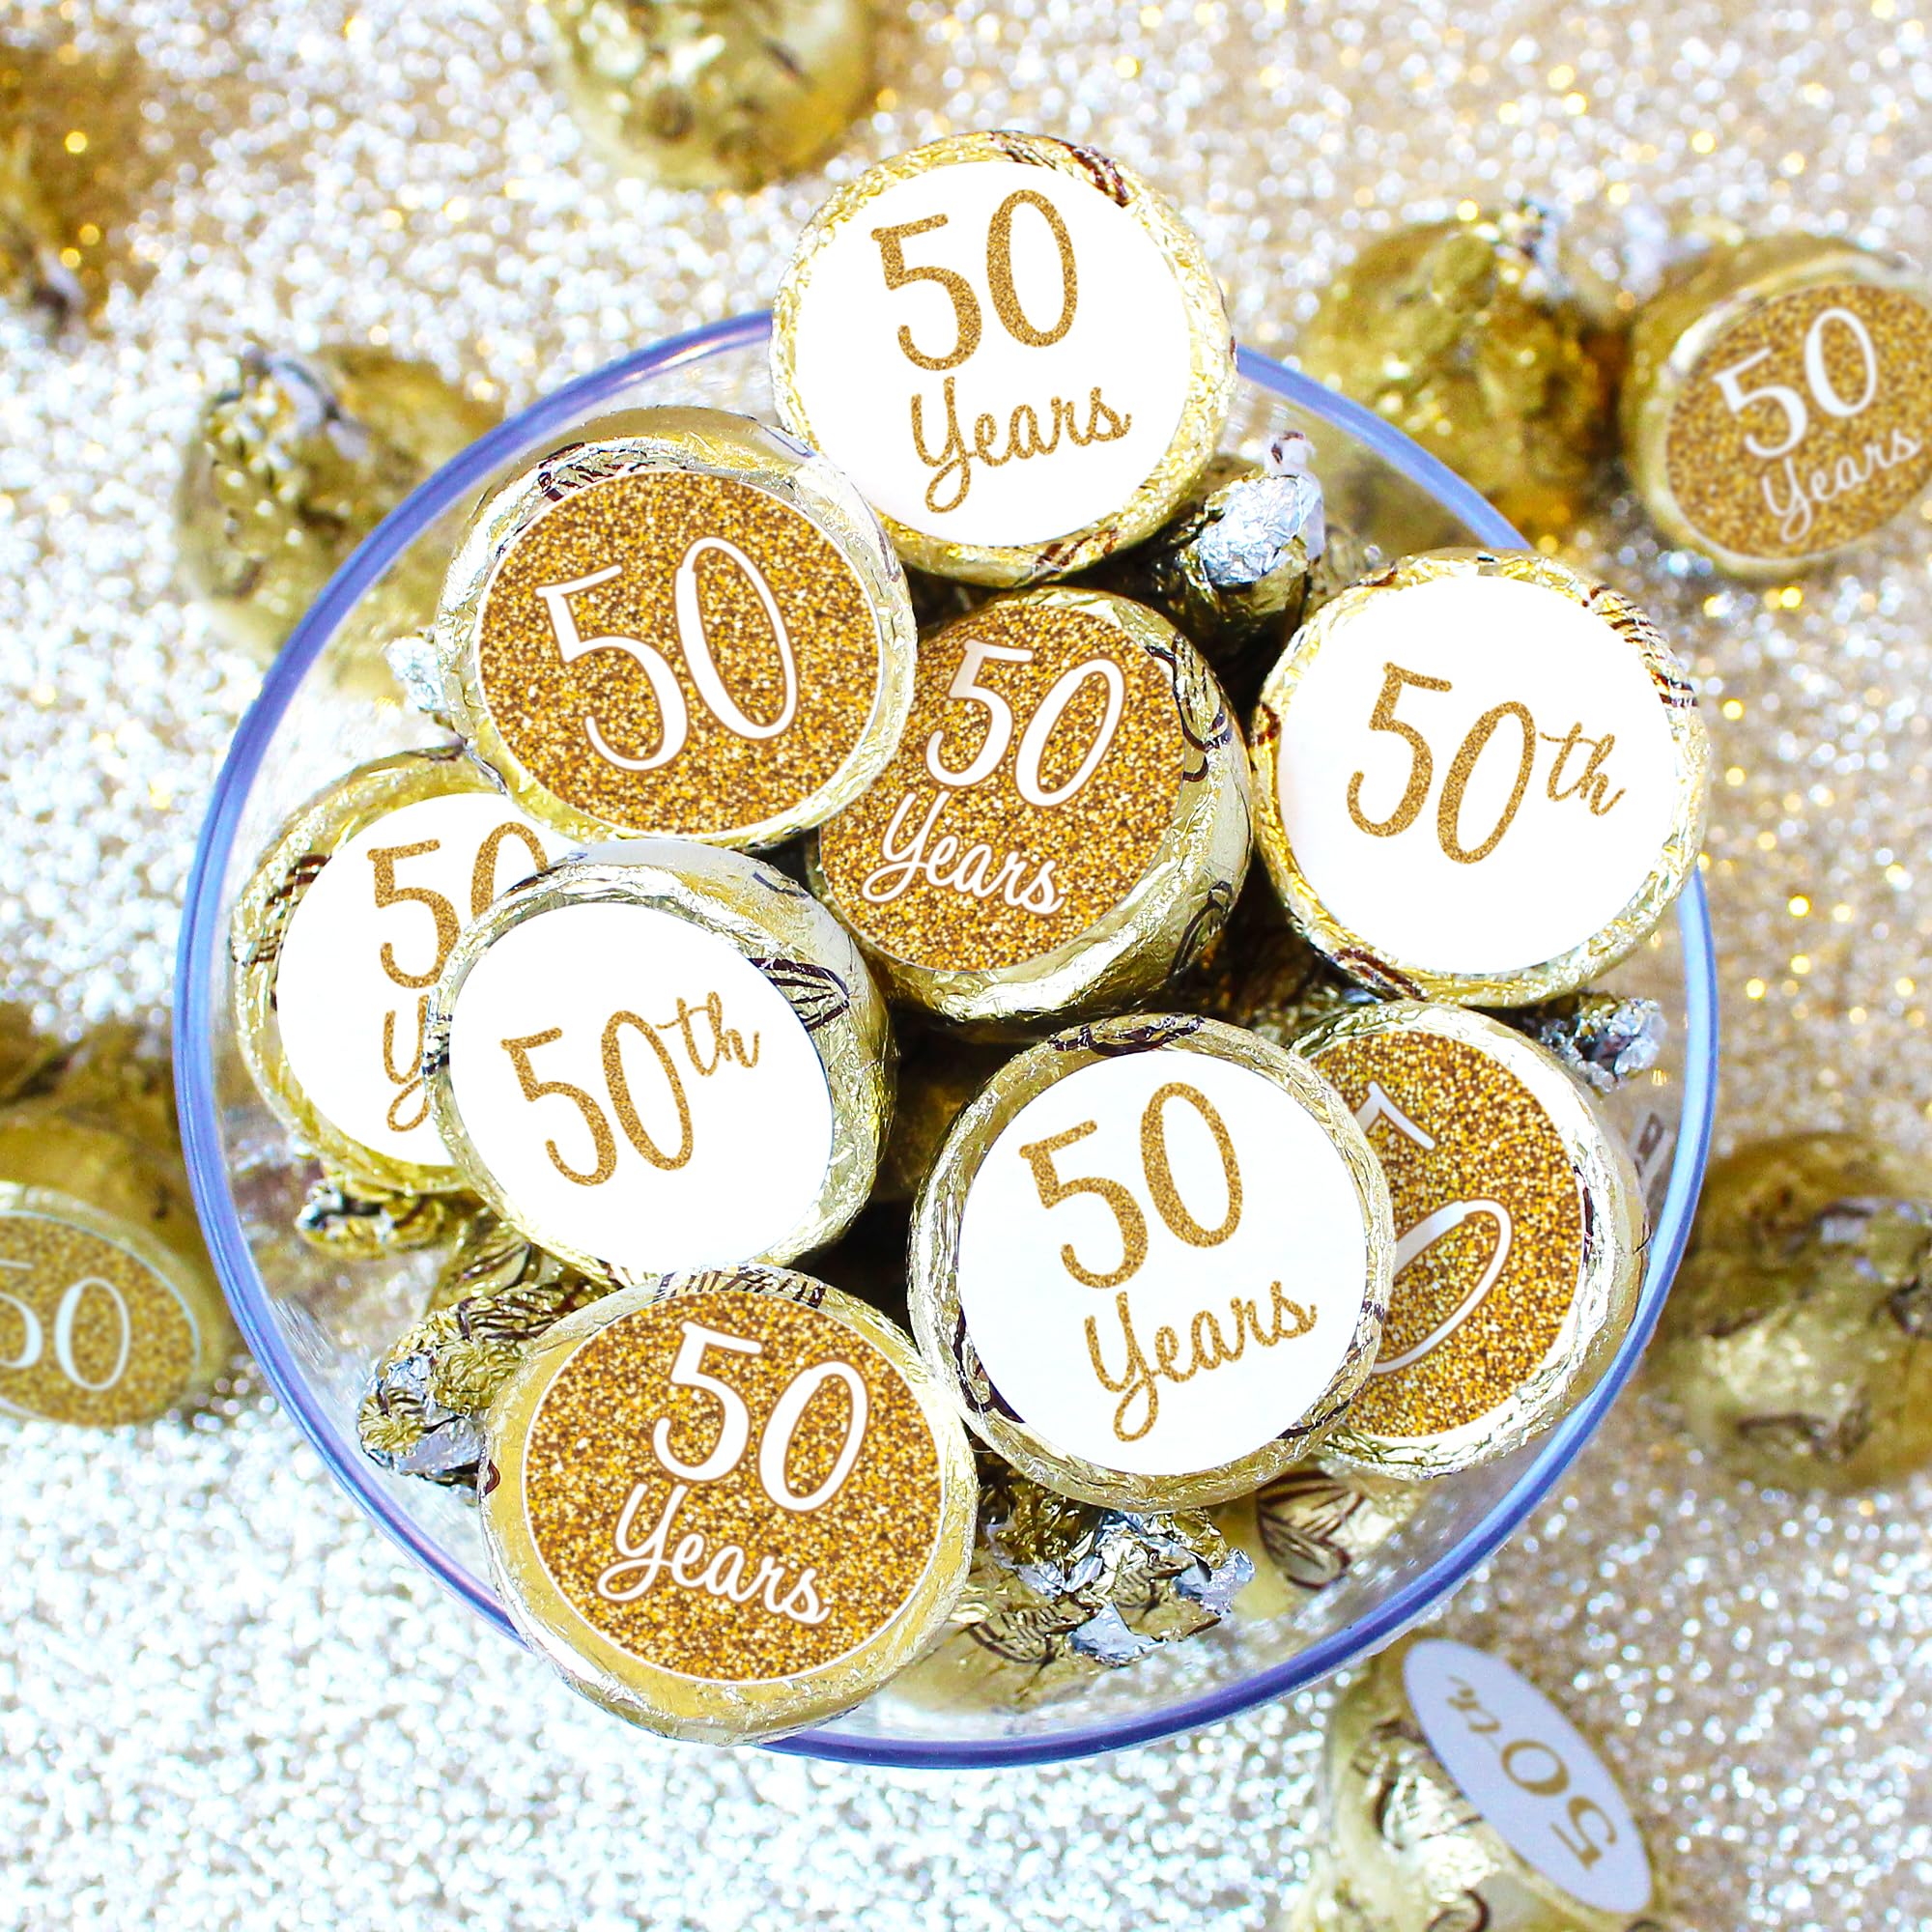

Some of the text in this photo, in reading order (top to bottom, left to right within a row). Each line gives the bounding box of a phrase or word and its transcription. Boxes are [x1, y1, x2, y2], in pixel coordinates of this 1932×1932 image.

[870, 188, 1078, 371] 50
[910, 376, 1131, 513] Years
[1713, 307, 1877, 458] 50
[1762, 429, 1921, 542] Years
[535, 537, 797, 771] 50
[925, 639, 1124, 807] 50
[1347, 662, 1627, 864] 50th
[862, 790, 1065, 915] Years
[500, 991, 760, 1186] 50th
[1019, 1082, 1243, 1289] 50
[653, 1321, 868, 1511] 50
[1085, 1280, 1318, 1442] Years
[597, 1483, 832, 1624] Years
